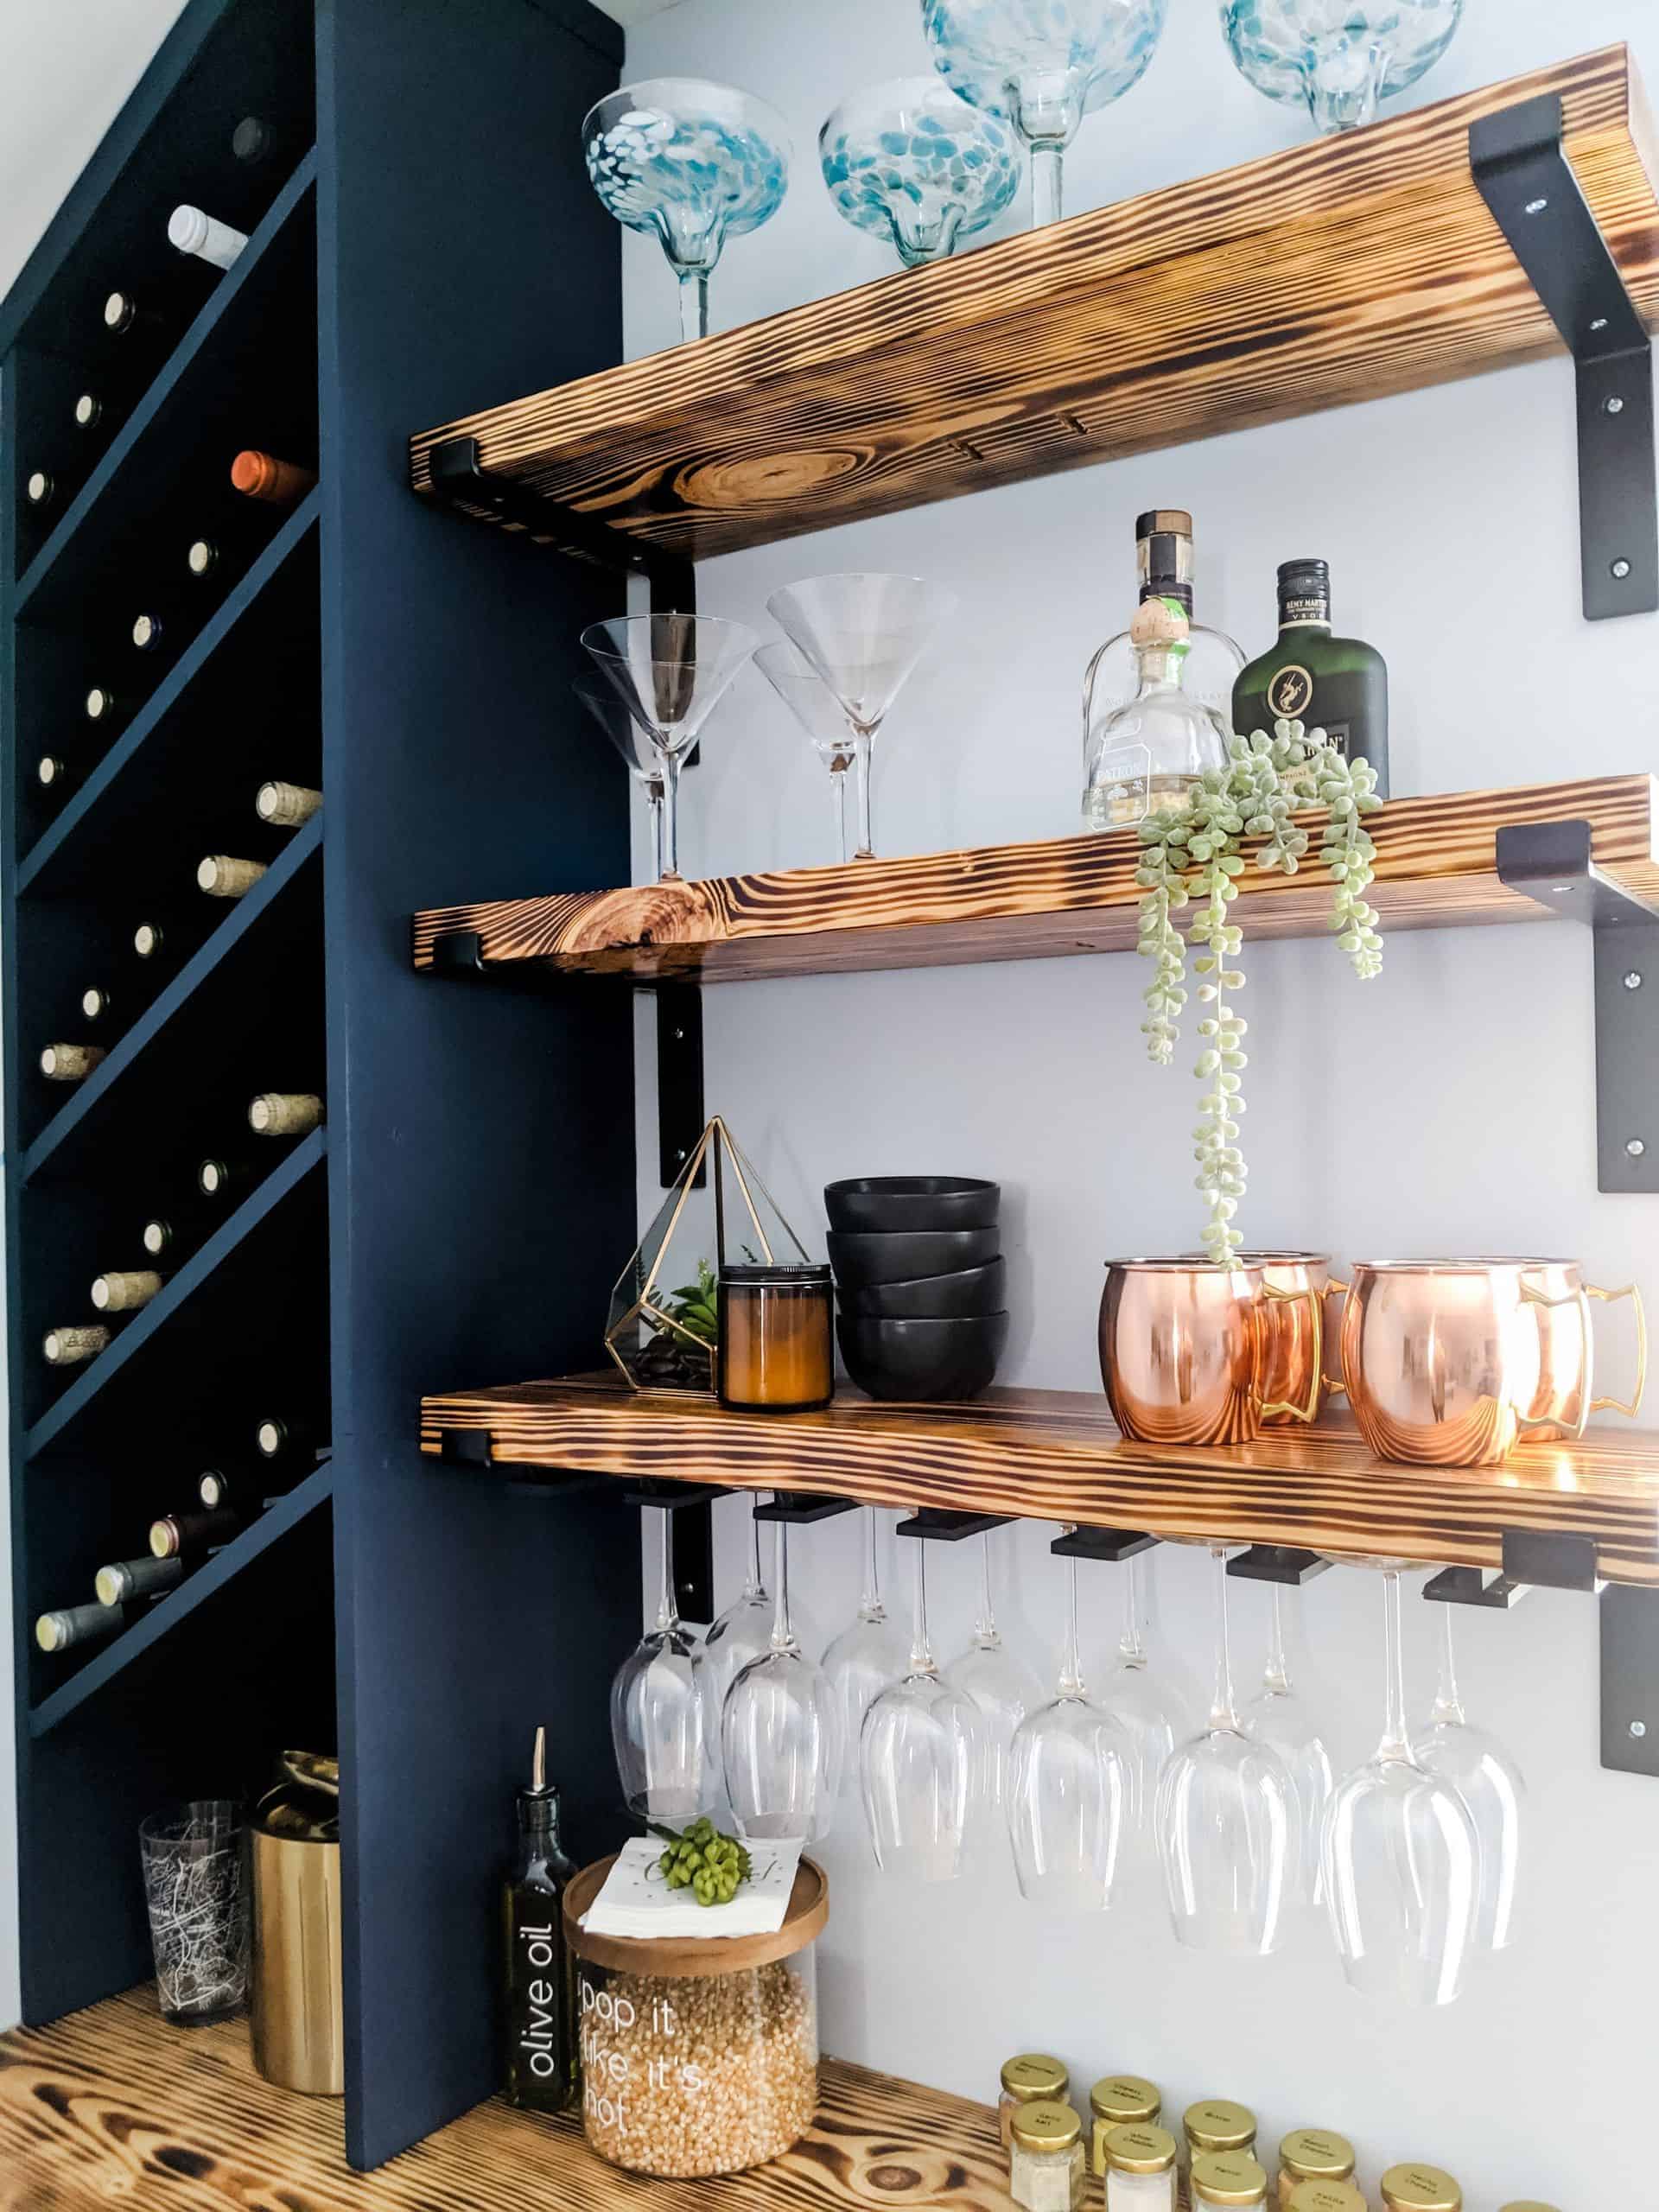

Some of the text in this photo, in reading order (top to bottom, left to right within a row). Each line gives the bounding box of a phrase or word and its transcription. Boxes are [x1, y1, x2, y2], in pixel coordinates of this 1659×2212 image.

[519, 1923, 554, 2077] olive oil
[582, 1979, 675, 2035] pop it
[583, 2024, 702, 2091] like it's
[585, 2075, 627, 2137] hot
